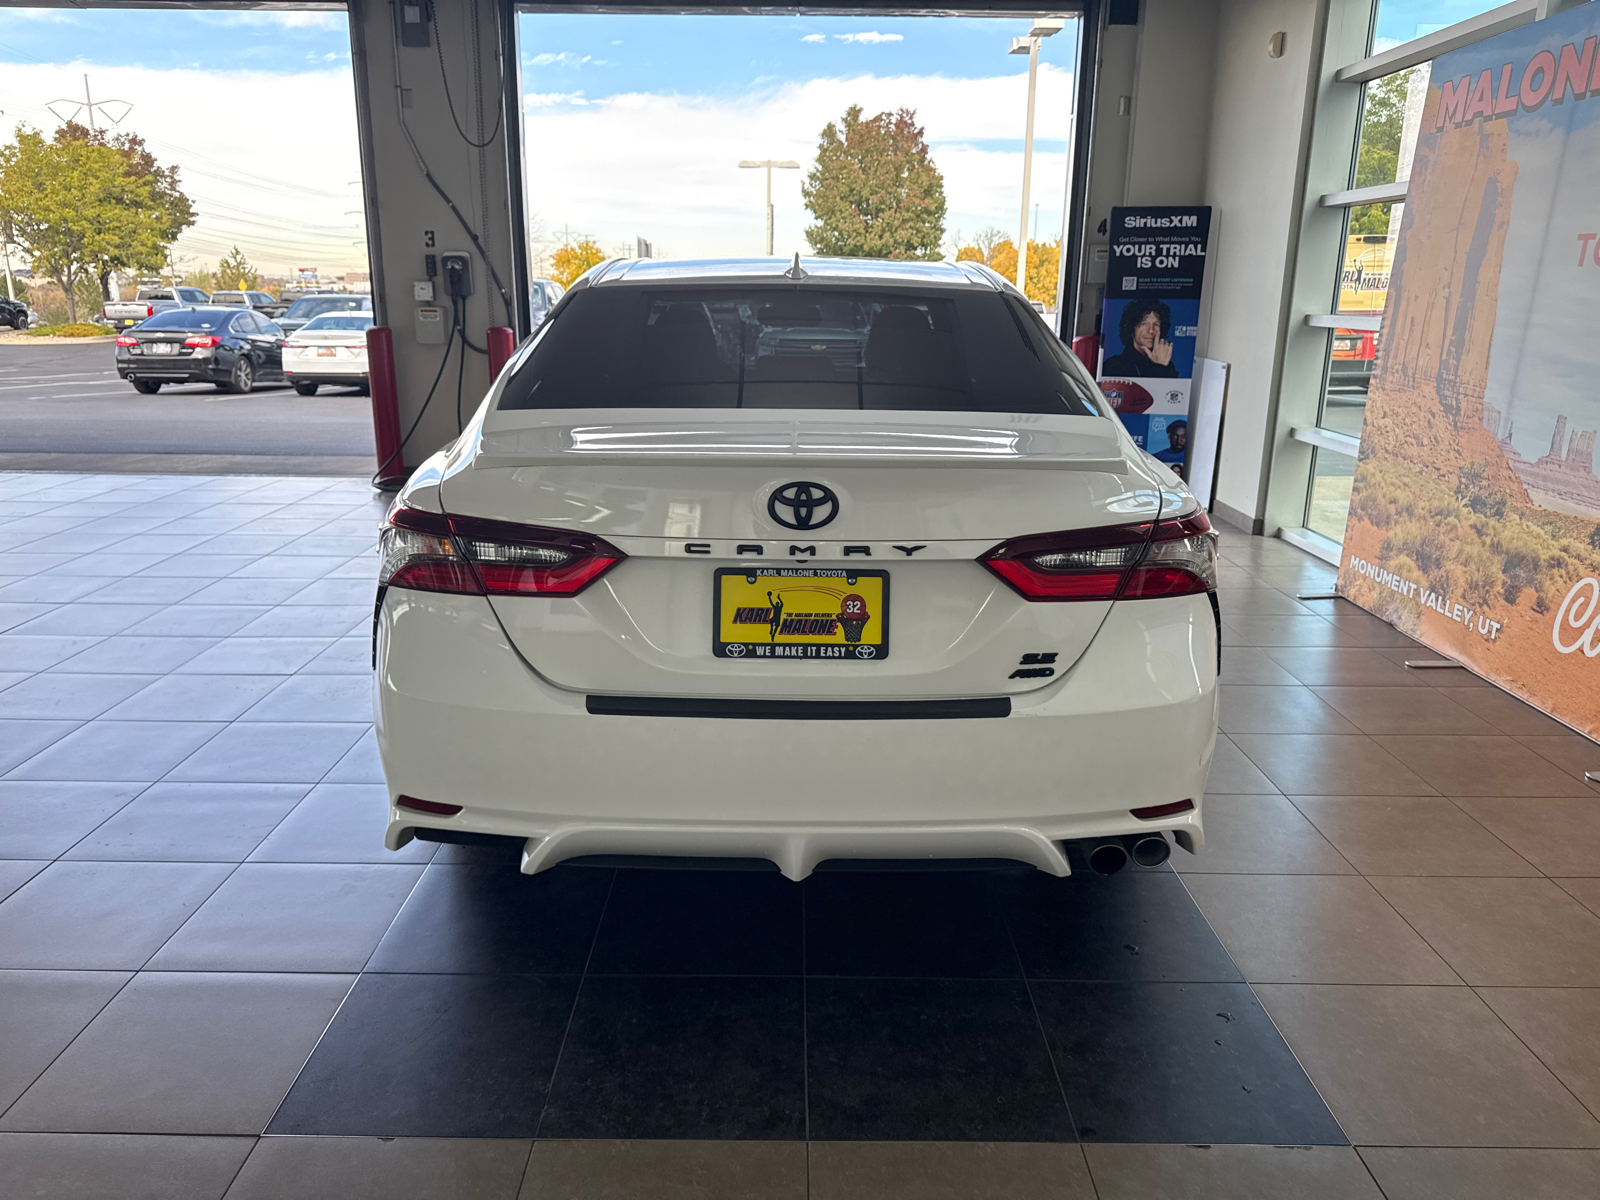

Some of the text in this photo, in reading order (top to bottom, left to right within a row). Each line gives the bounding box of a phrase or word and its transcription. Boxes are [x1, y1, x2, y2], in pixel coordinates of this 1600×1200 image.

[1097, 218, 1108, 236] 4
[1124, 215, 1198, 228] SiriusXM
[424, 230, 435, 247] 3
[1113, 244, 1156, 257] YOUR
[1160, 244, 1206, 256] TRIAL
[1137, 257, 1179, 268] IS ON
[684, 542, 928, 557] CAMRY
[756, 569, 848, 578] KARL MALONE TOYOTA
[1350, 554, 1501, 640] MONUMENT VALLEY, UT
[846, 600, 862, 613] 32
[732, 607, 773, 624] KARL
[778, 618, 838, 635] MALONE
[756, 646, 846, 657] WE MAKE IT EASY
[1018, 652, 1059, 665] SE
